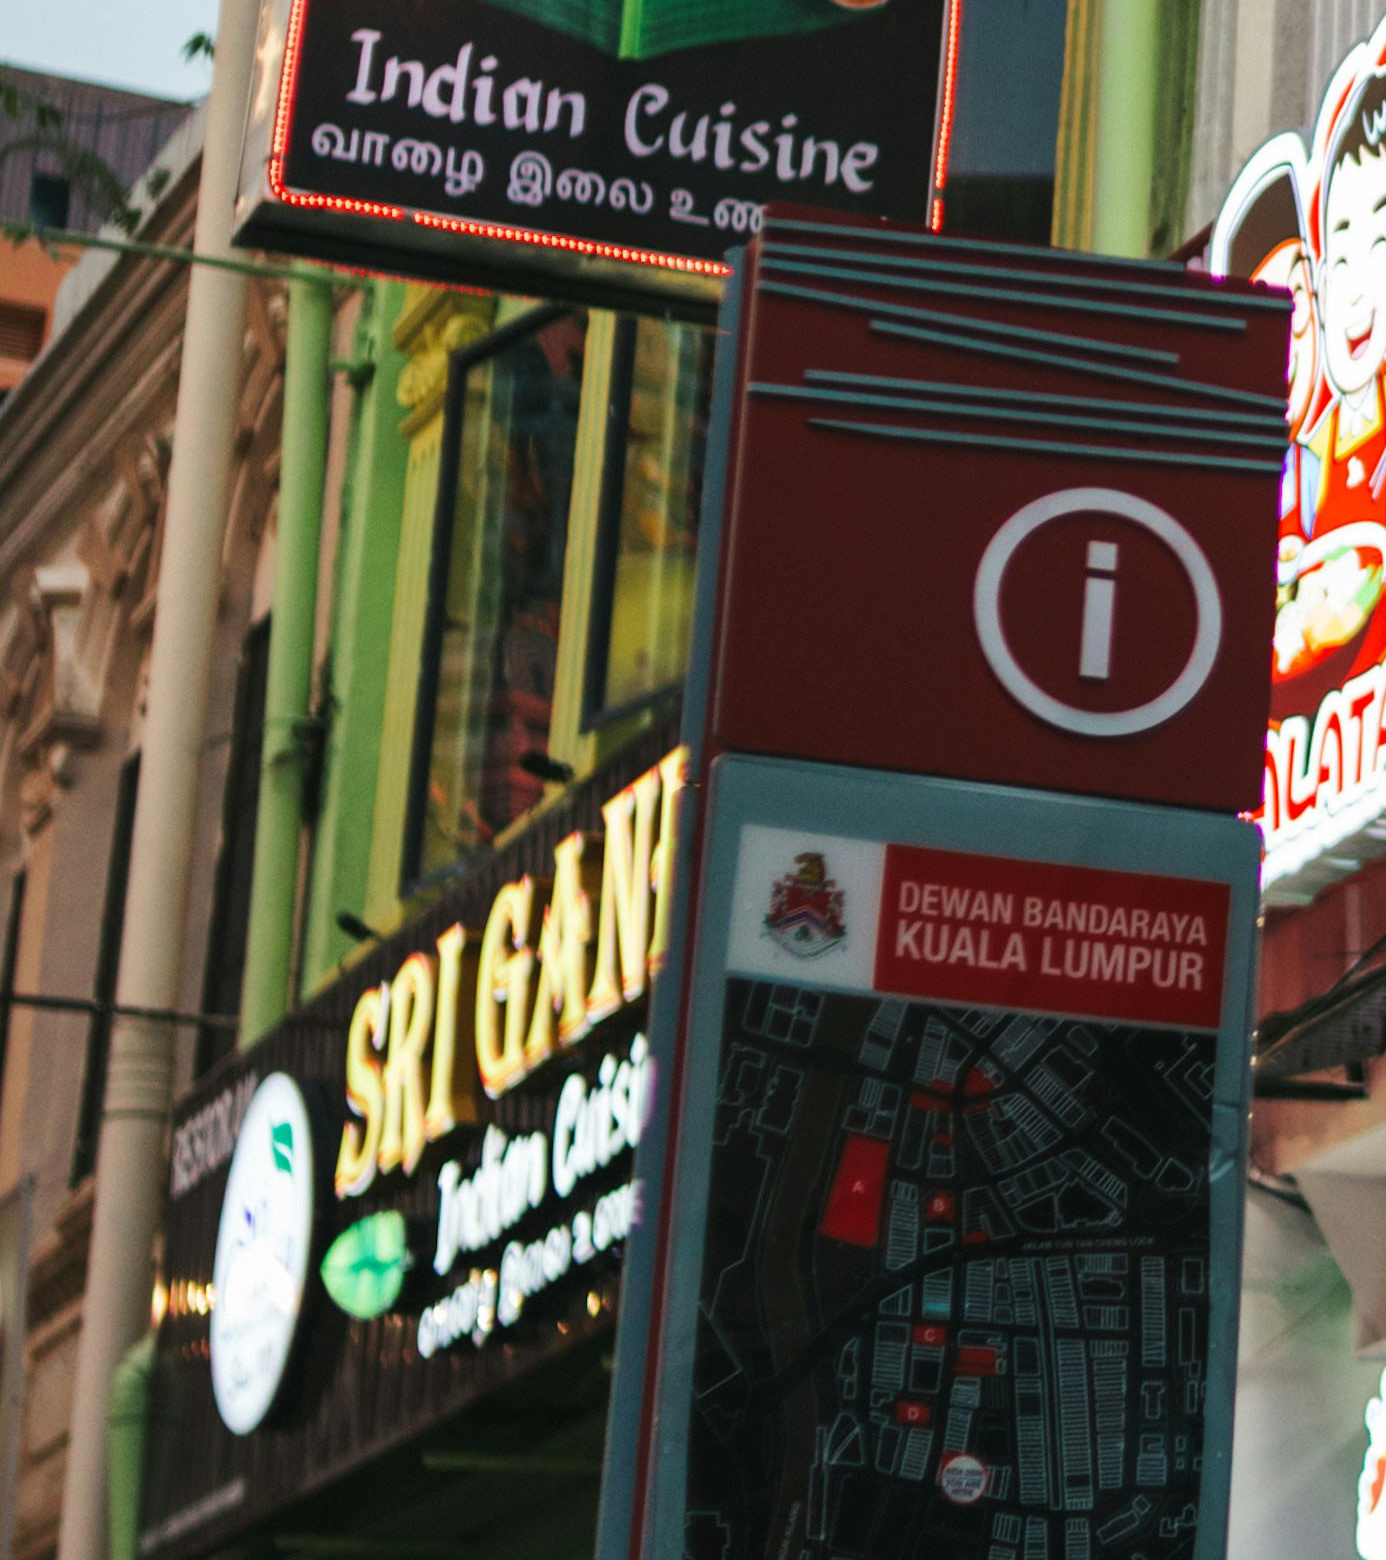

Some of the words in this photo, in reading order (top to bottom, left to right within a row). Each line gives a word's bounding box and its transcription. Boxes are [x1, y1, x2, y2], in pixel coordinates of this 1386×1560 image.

[345, 27, 587, 139] Indian
[623, 83, 879, 193] Cuisine
[311, 122, 485, 197] வாழை
[506, 150, 655, 215] இலை
[895, 918, 1028, 973] KUALA
[1040, 936, 1205, 992] LUMPUR
[898, 880, 1013, 926] DEWAN
[1023, 896, 1209, 947] BANDARAYA
[336, 922, 466, 1199] SRI
